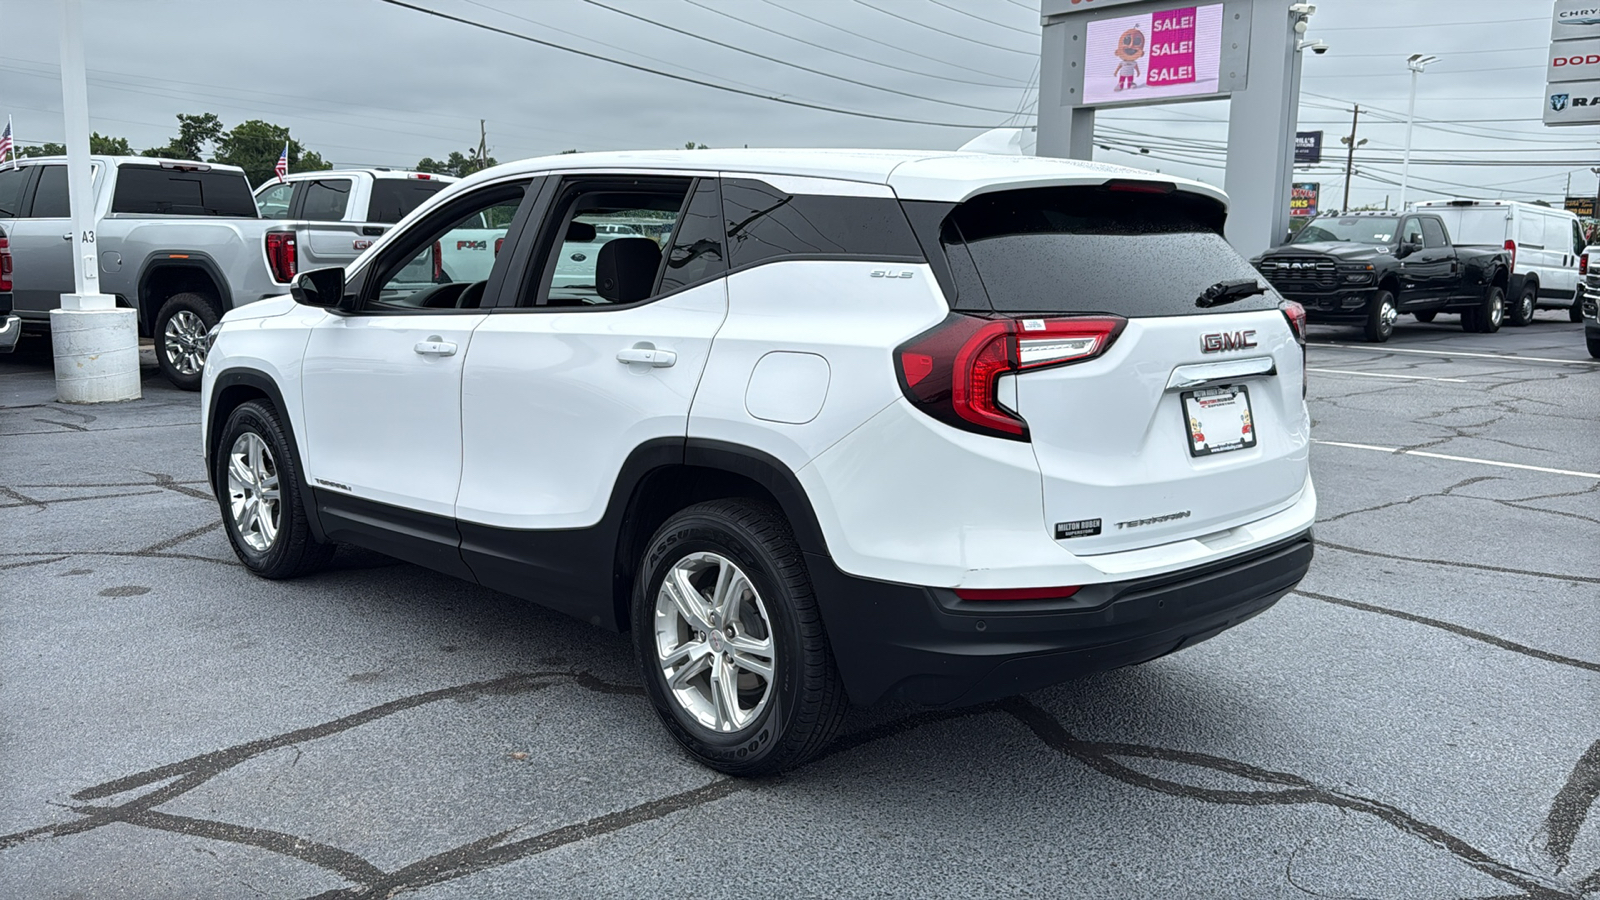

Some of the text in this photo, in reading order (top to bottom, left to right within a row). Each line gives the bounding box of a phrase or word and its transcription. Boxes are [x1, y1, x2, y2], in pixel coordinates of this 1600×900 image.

[1559, 8, 1600, 18] CHRY
[1153, 16, 1193, 32] SALE!
[1151, 41, 1193, 56] SALE!
[1149, 66, 1193, 82] SALE!
[81, 230, 95, 243] A3
[456, 240, 487, 251] FX4
[1277, 262, 1316, 270] RAM
[870, 270, 914, 279] SLE
[1200, 330, 1258, 354] GMC
[1114, 510, 1191, 530] TERRAIN
[1057, 522, 1080, 532] MILTON
